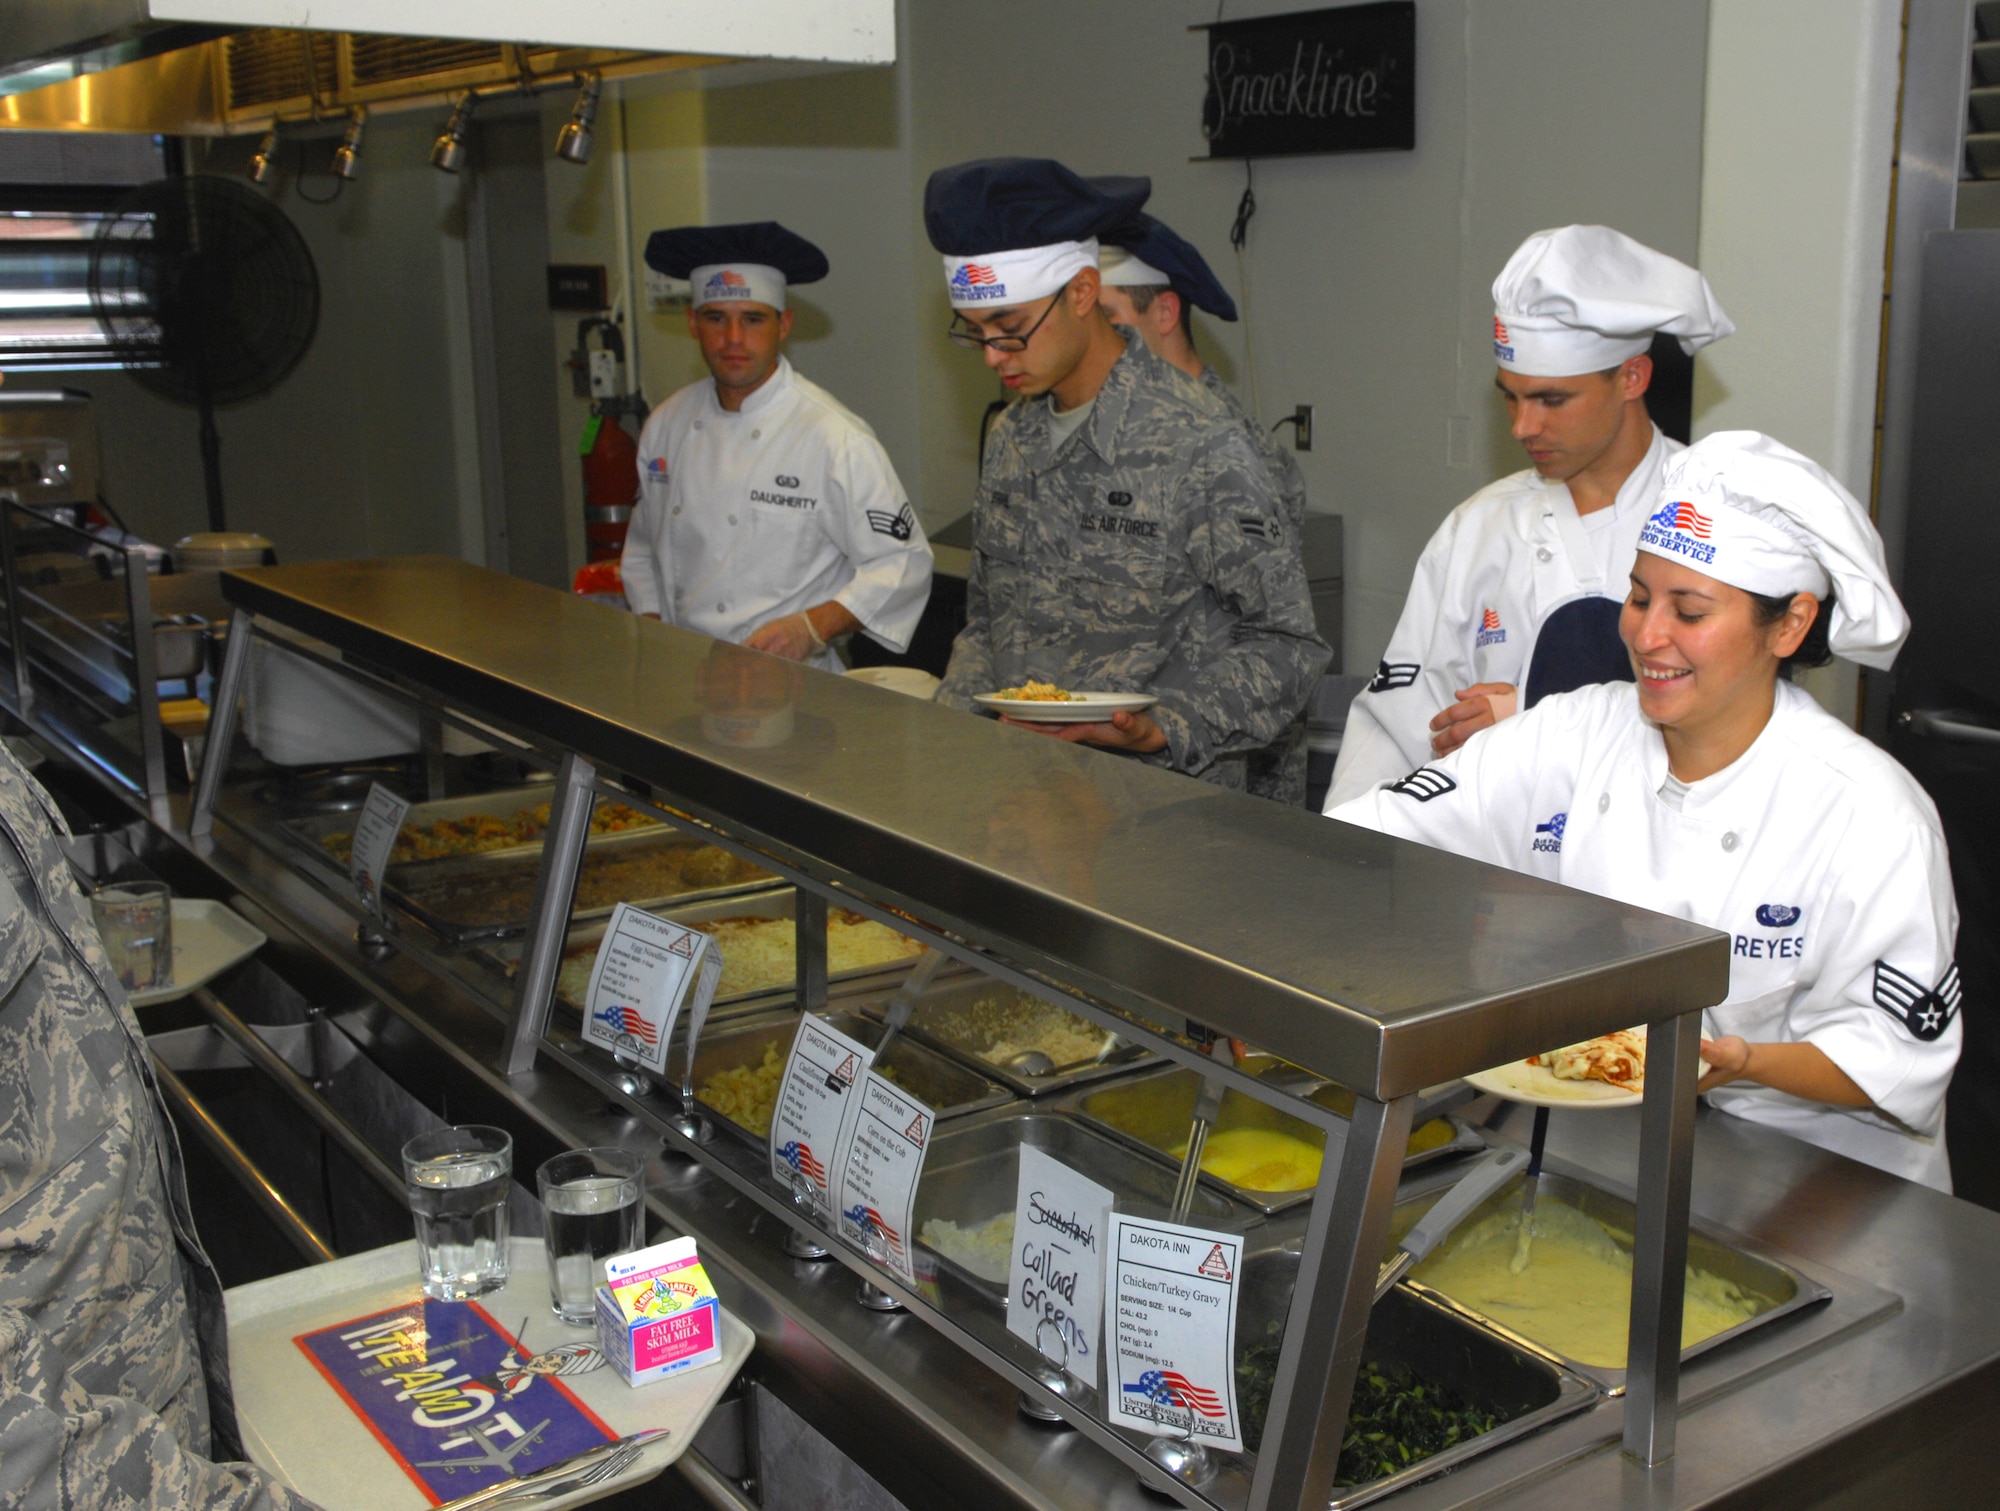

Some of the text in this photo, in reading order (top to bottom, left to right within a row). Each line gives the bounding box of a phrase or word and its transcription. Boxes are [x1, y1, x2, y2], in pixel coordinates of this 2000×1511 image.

[1203, 40, 1377, 140] Snackline
[750, 490, 818, 510] DAUGHERTY
[1099, 516, 1117, 533] AIR
[1118, 518, 1159, 538] FORCE
[1659, 537, 1715, 564] SERVICE
[1674, 531, 1716, 553] SERVICES
[1532, 843, 1561, 853] FOOD
[628, 914, 669, 936] DAKOTA INN
[1734, 935, 1804, 959] REYES
[806, 1032, 838, 1058] DAKOTA INN
[871, 1088, 905, 1117] DAKOTA INN
[867, 1124, 879, 1139] Corn
[895, 1144, 906, 1158] Cob
[1130, 1233, 1191, 1255] DAKOTA INN
[621, 1262, 684, 1286] FAT FREE SKIM MILK
[635, 1290, 654, 1308] LAND
[670, 1283, 694, 1295] LAKES
[1122, 1274, 1220, 1307] Chicken/Turkey Gravy
[1021, 1278, 1089, 1355] Greens
[1120, 1294, 1192, 1318] SERVING SIZE: 1/4 Cup
[1120, 1307, 1148, 1320] CAL: 43.2
[647, 1323, 701, 1350] SKIM MILK
[651, 1314, 694, 1338] FAT FREE
[1119, 1321, 1158, 1337] CHOL (mg): 0
[1120, 1334, 1131, 1343] FAT
[1143, 1340, 1152, 1349] 3.4
[1120, 1348, 1144, 1360] SODIUM
[1161, 1359, 1173, 1368] 12.5
[362, 1331, 472, 1413] TEAM
[1198, 1418, 1225, 1428] FORCE
